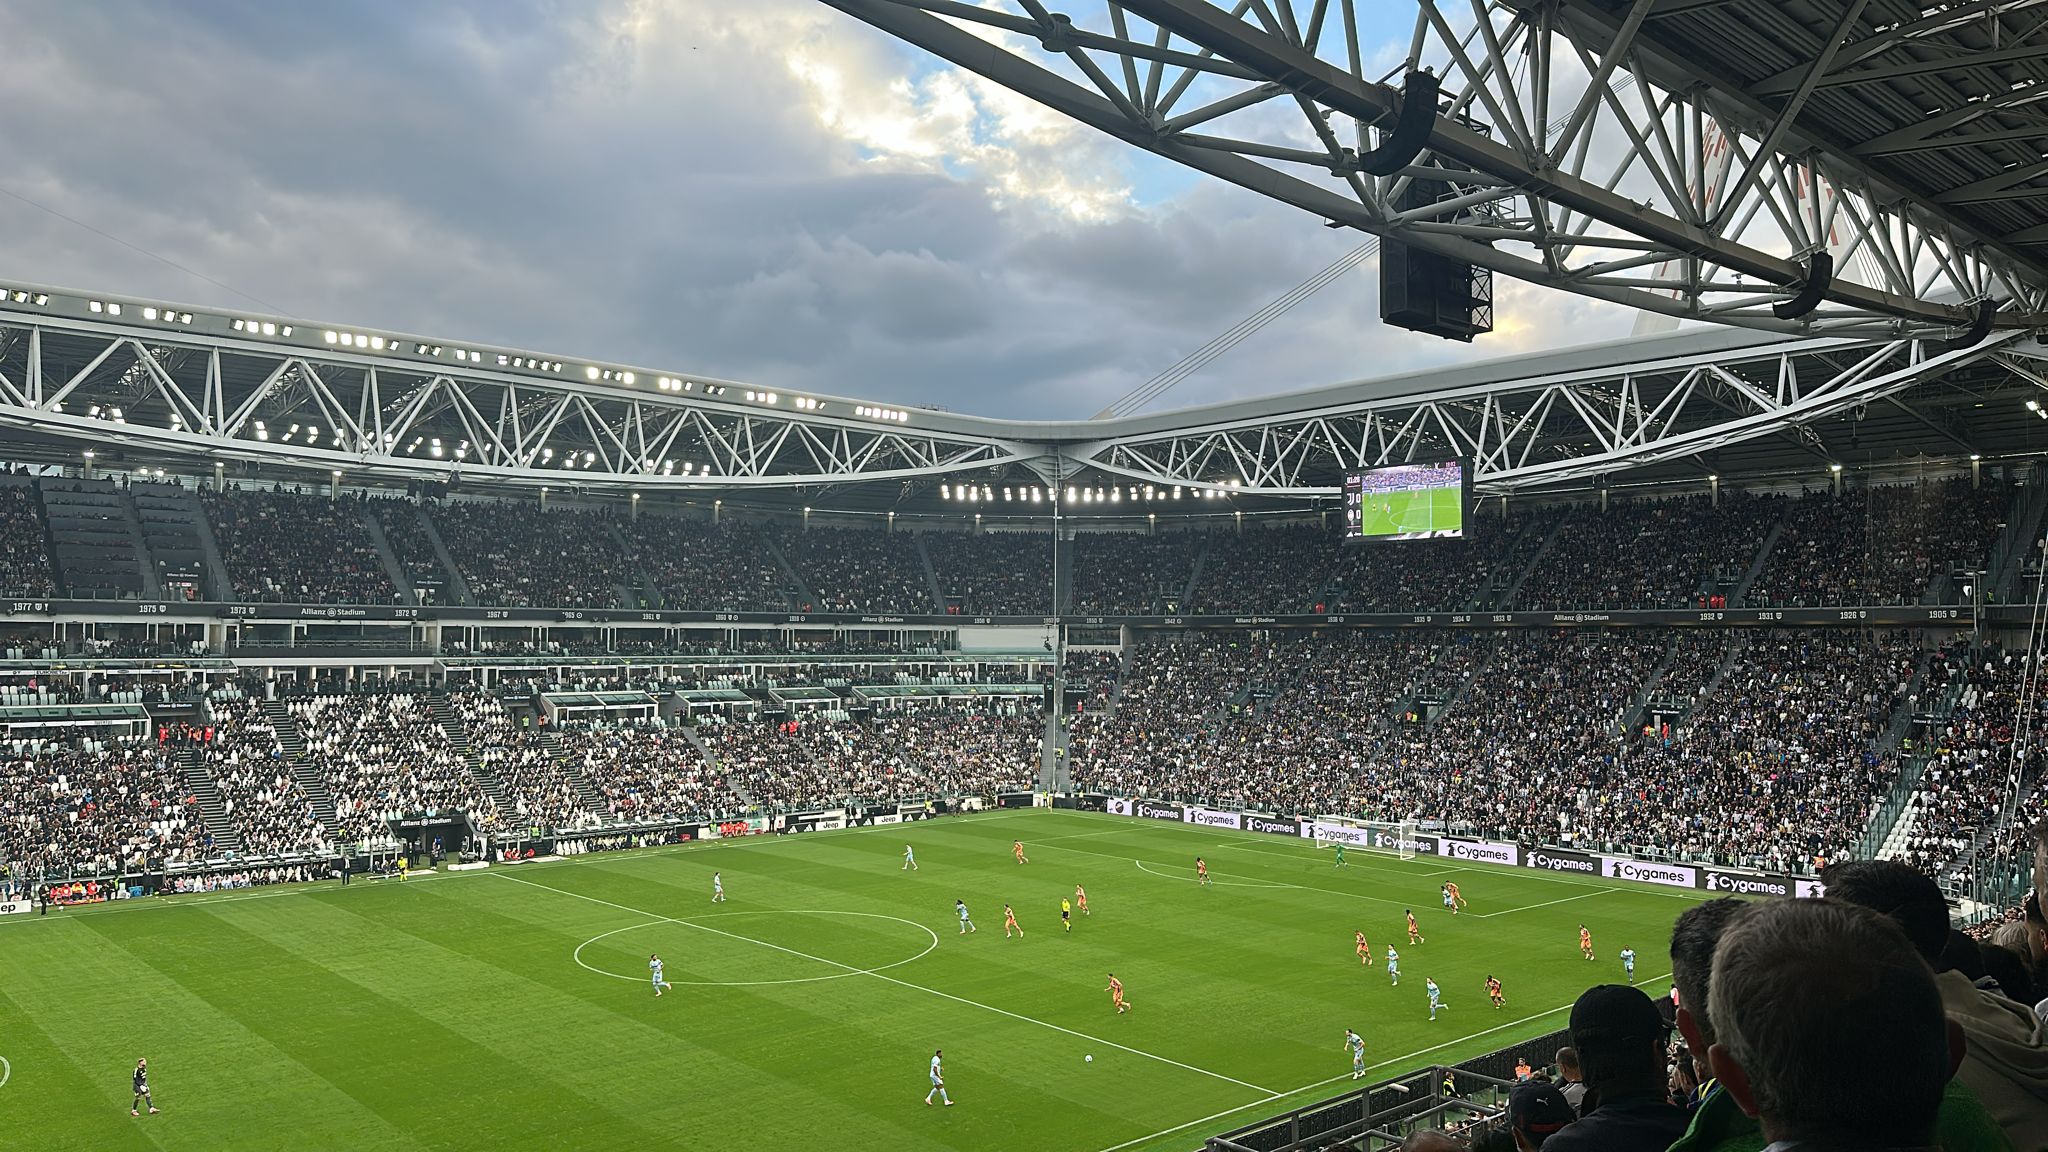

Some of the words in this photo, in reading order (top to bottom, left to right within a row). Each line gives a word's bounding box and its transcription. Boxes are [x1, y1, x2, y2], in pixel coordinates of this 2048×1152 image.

[13, 602, 32, 611] 1977
[139, 605, 157, 613] 1975
[230, 606, 247, 615] 1973
[301, 607, 326, 615] Allianz
[395, 609, 410, 617] 1972
[1700, 613, 1715, 621] 1932
[1758, 612, 1774, 620] 1931
[1840, 611, 1857, 619] 1926
[1929, 610, 1947, 619] 1905
[1553, 614, 1575, 622] Allianz
[1144, 806, 1179, 819] Cygames
[880, 815, 896, 823] Jeep
[1197, 812, 1234, 826] Cygames
[823, 821, 839, 830] Jeep
[1255, 820, 1295, 833] Cygames
[1316, 827, 1360, 842] Cygames
[1456, 844, 1509, 861] Cygames
[1537, 853, 1594, 872] Cygames
[1624, 865, 1685, 883] Cygames
[1718, 876, 1786, 896] Cygames
